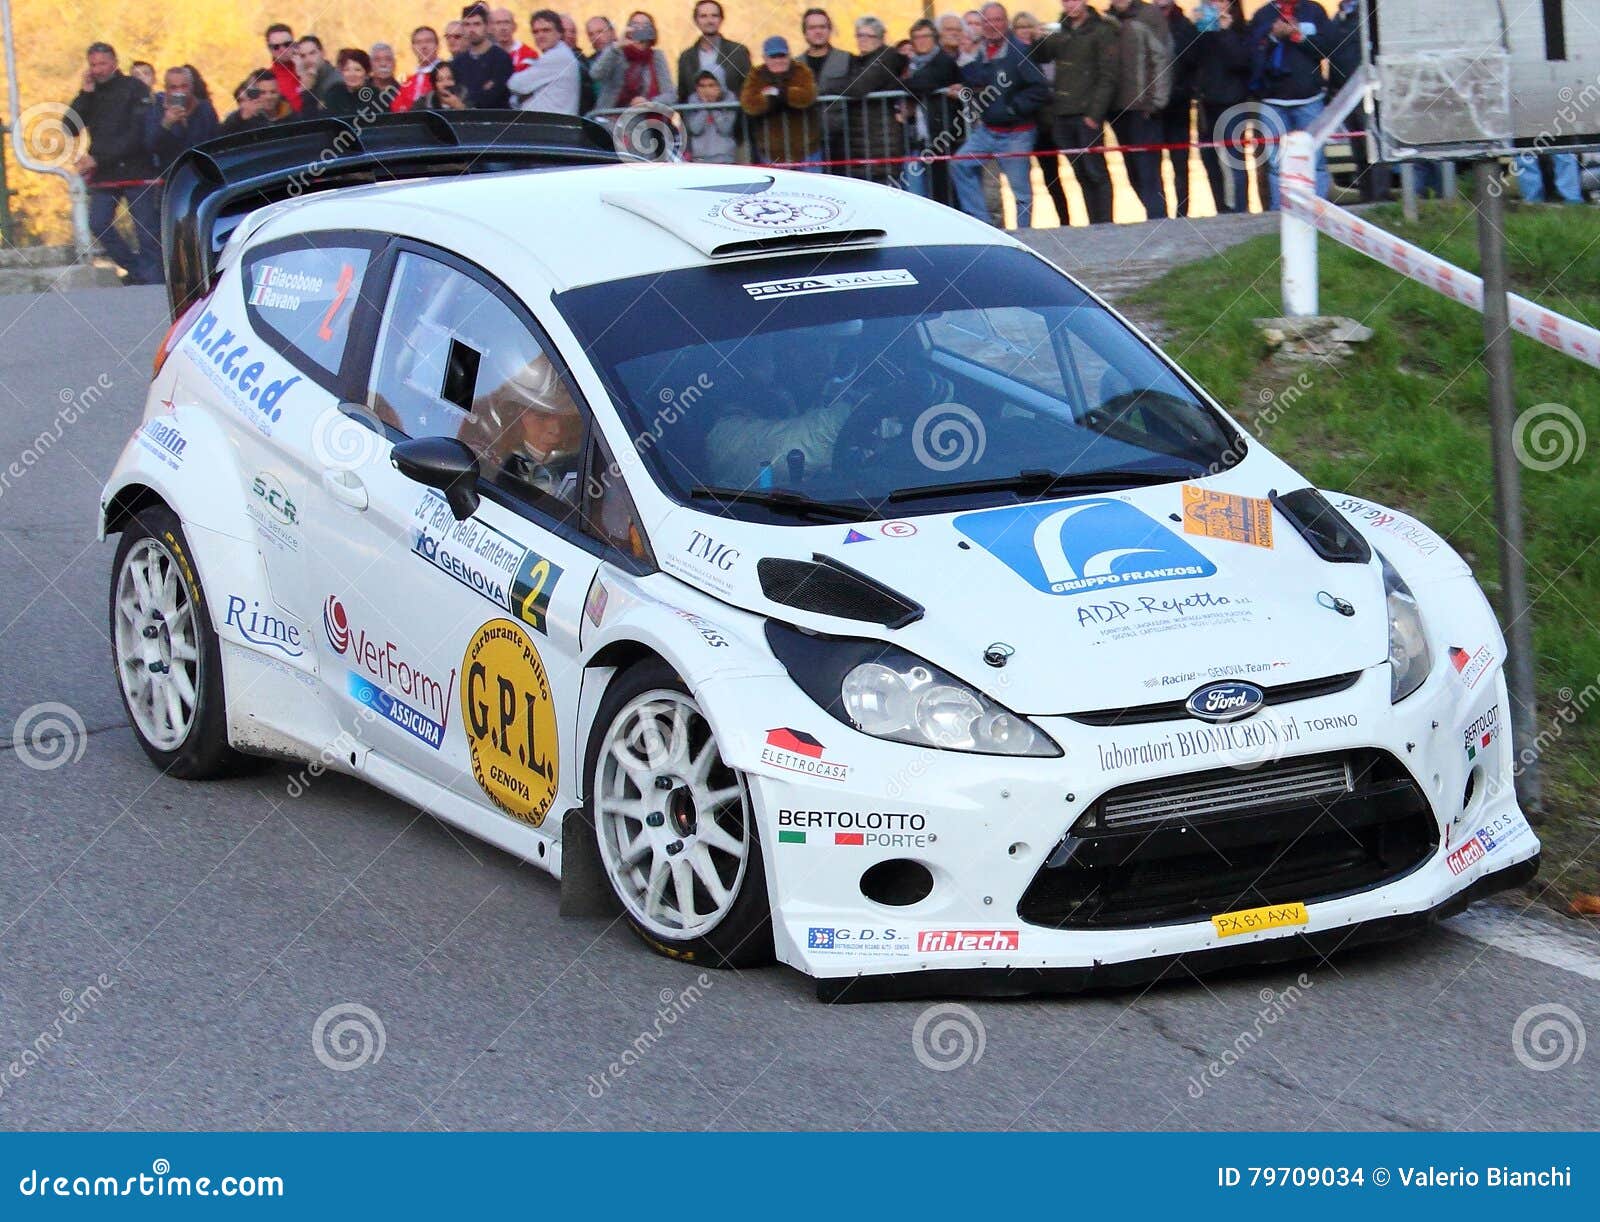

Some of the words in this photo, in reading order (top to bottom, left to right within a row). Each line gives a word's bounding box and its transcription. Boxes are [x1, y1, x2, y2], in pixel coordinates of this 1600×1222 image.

[270, 267, 323, 293] Giacobone
[746, 280, 824, 296] DELTA
[836, 273, 908, 286] RALLY
[262, 286, 300, 311] Ravano
[452, 520, 478, 550] della
[474, 530, 519, 575] Lanterna
[686, 530, 740, 571] TMG
[440, 551, 506, 605] GENOVA
[521, 559, 550, 628] 2
[1051, 575, 1121, 593] GRUPPO
[1122, 566, 1204, 581] FRANZOSI
[224, 594, 303, 657] Rime
[471, 627, 523, 660] carburante
[522, 645, 548, 701] pulito
[1207, 664, 1244, 679] GENOVA
[1245, 661, 1271, 673] Team
[1206, 688, 1247, 711] Ford
[390, 702, 440, 745] ASSICURA
[468, 661, 554, 783] G.P.L.
[1098, 734, 1175, 772] laboratori
[1176, 719, 1280, 757] BIOMICRON
[1282, 716, 1300, 743] srl
[1304, 714, 1359, 733] TORINO
[761, 748, 847, 779] ELETTROCASA
[490, 765, 530, 801] GENOVA
[778, 810, 926, 831] BERTOLOTTO
[866, 834, 926, 848] PORTE
[1218, 917, 1242, 932] PX
[921, 931, 1015, 951] fri.tech.
